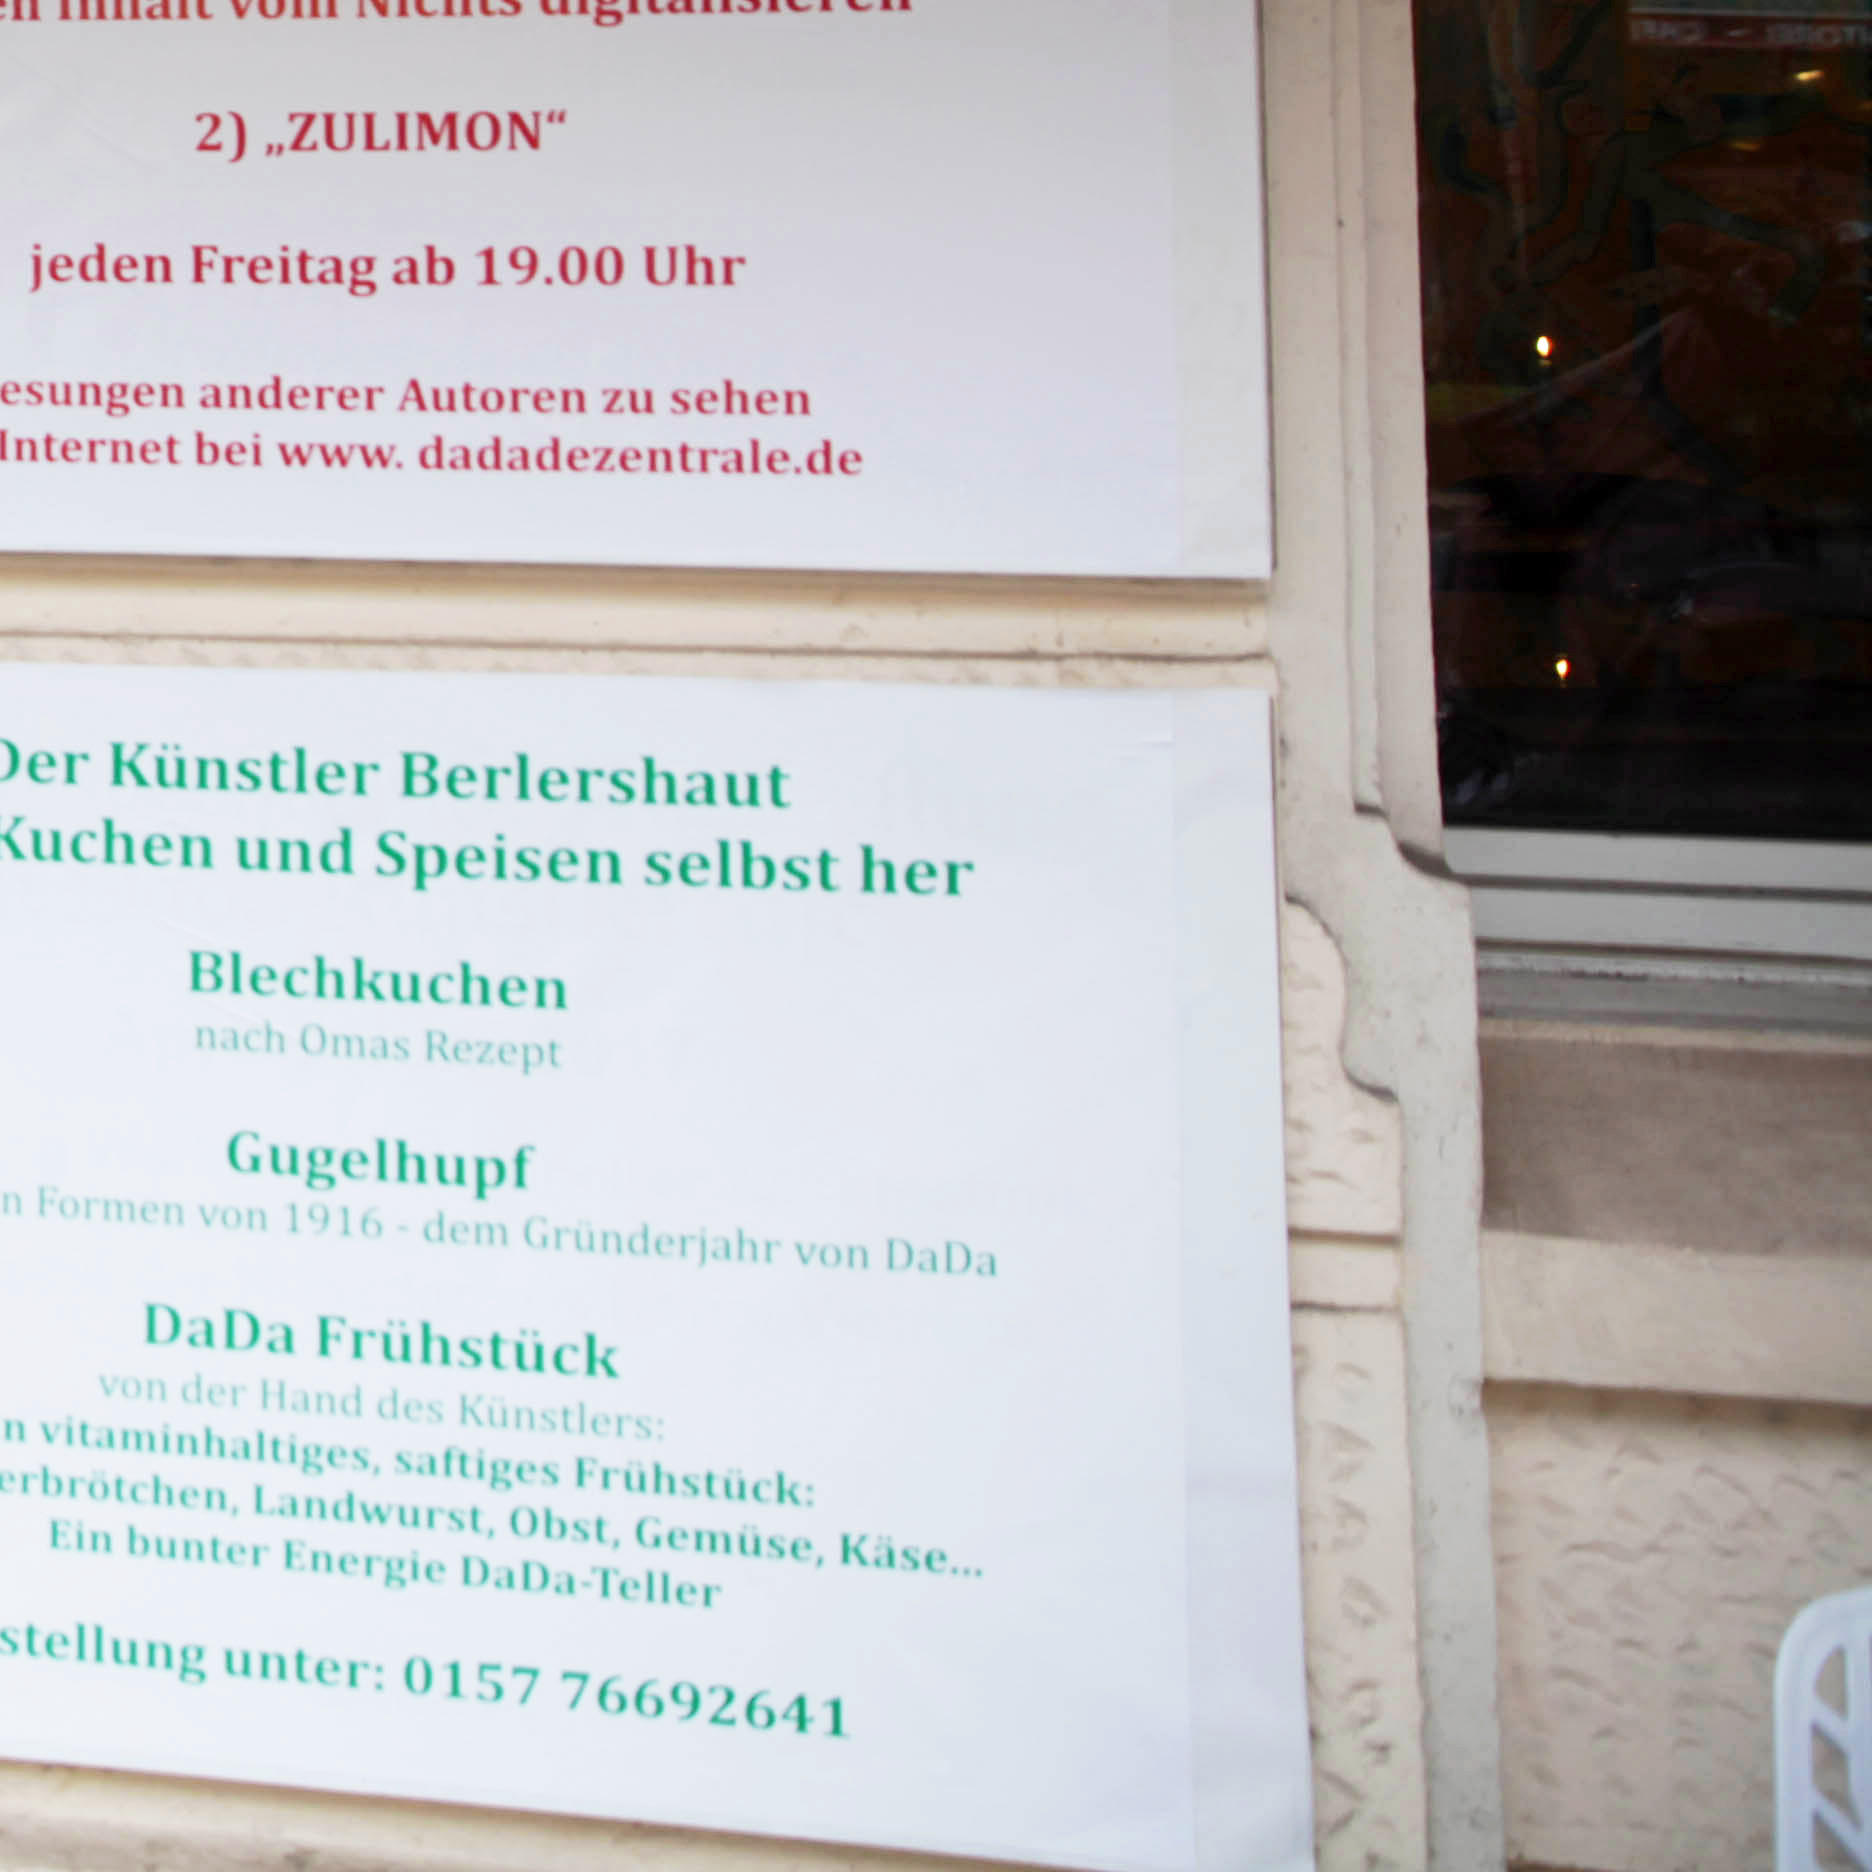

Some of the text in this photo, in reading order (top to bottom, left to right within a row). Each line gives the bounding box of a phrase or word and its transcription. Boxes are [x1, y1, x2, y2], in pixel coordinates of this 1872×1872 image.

[194, 110, 247, 163] 2)
[30, 241, 746, 296] jeden Freitag ab 19.00 Uhr
[198, 374, 384, 411] anderer
[397, 377, 586, 414] Autoren
[601, 387, 655, 414] zu
[670, 377, 810, 416] sehen
[194, 430, 262, 467] bei
[277, 442, 404, 469] www.
[418, 433, 863, 476] dadadezentrale.de
[111, 741, 380, 797] Künstler
[401, 751, 789, 808] Berlershaut
[236, 826, 353, 875] und
[375, 830, 622, 888] Speisen
[645, 838, 838, 892] selbst
[861, 843, 974, 896] her
[190, 950, 567, 1010] Blechkuchen
[194, 1019, 560, 1078] nach Omas Rezept
[226, 1131, 535, 1201] Gugelhupf
[37, 1185, 185, 1226] Formen
[197, 1204, 268, 1232] von
[286, 1201, 384, 1238] 1916
[421, 1209, 509, 1248] dem
[522, 1214, 781, 1268] Gründerjahr
[793, 1241, 871, 1271] von
[885, 1236, 998, 1278] DaDa
[145, 1303, 619, 1379] DaDa Frühstück
[98, 1370, 664, 1440] von der Hand des Künstlers:
[39, 1417, 380, 1476] vitaminhaltiges,
[395, 1446, 560, 1491] saftiges
[575, 1455, 813, 1507] Frühstück:
[49, 1519, 722, 1609] Ein bunter Energie DaDa-Teller
[254, 1484, 495, 1539] Landwurst,
[508, 1506, 620, 1549] Obst,
[634, 1516, 825, 1568] Gemüse,
[839, 1532, 983, 1577] Käse...
[224, 1647, 384, 1691] unter:
[403, 1656, 541, 1705] 0157
[561, 1670, 844, 1738] 76692641
